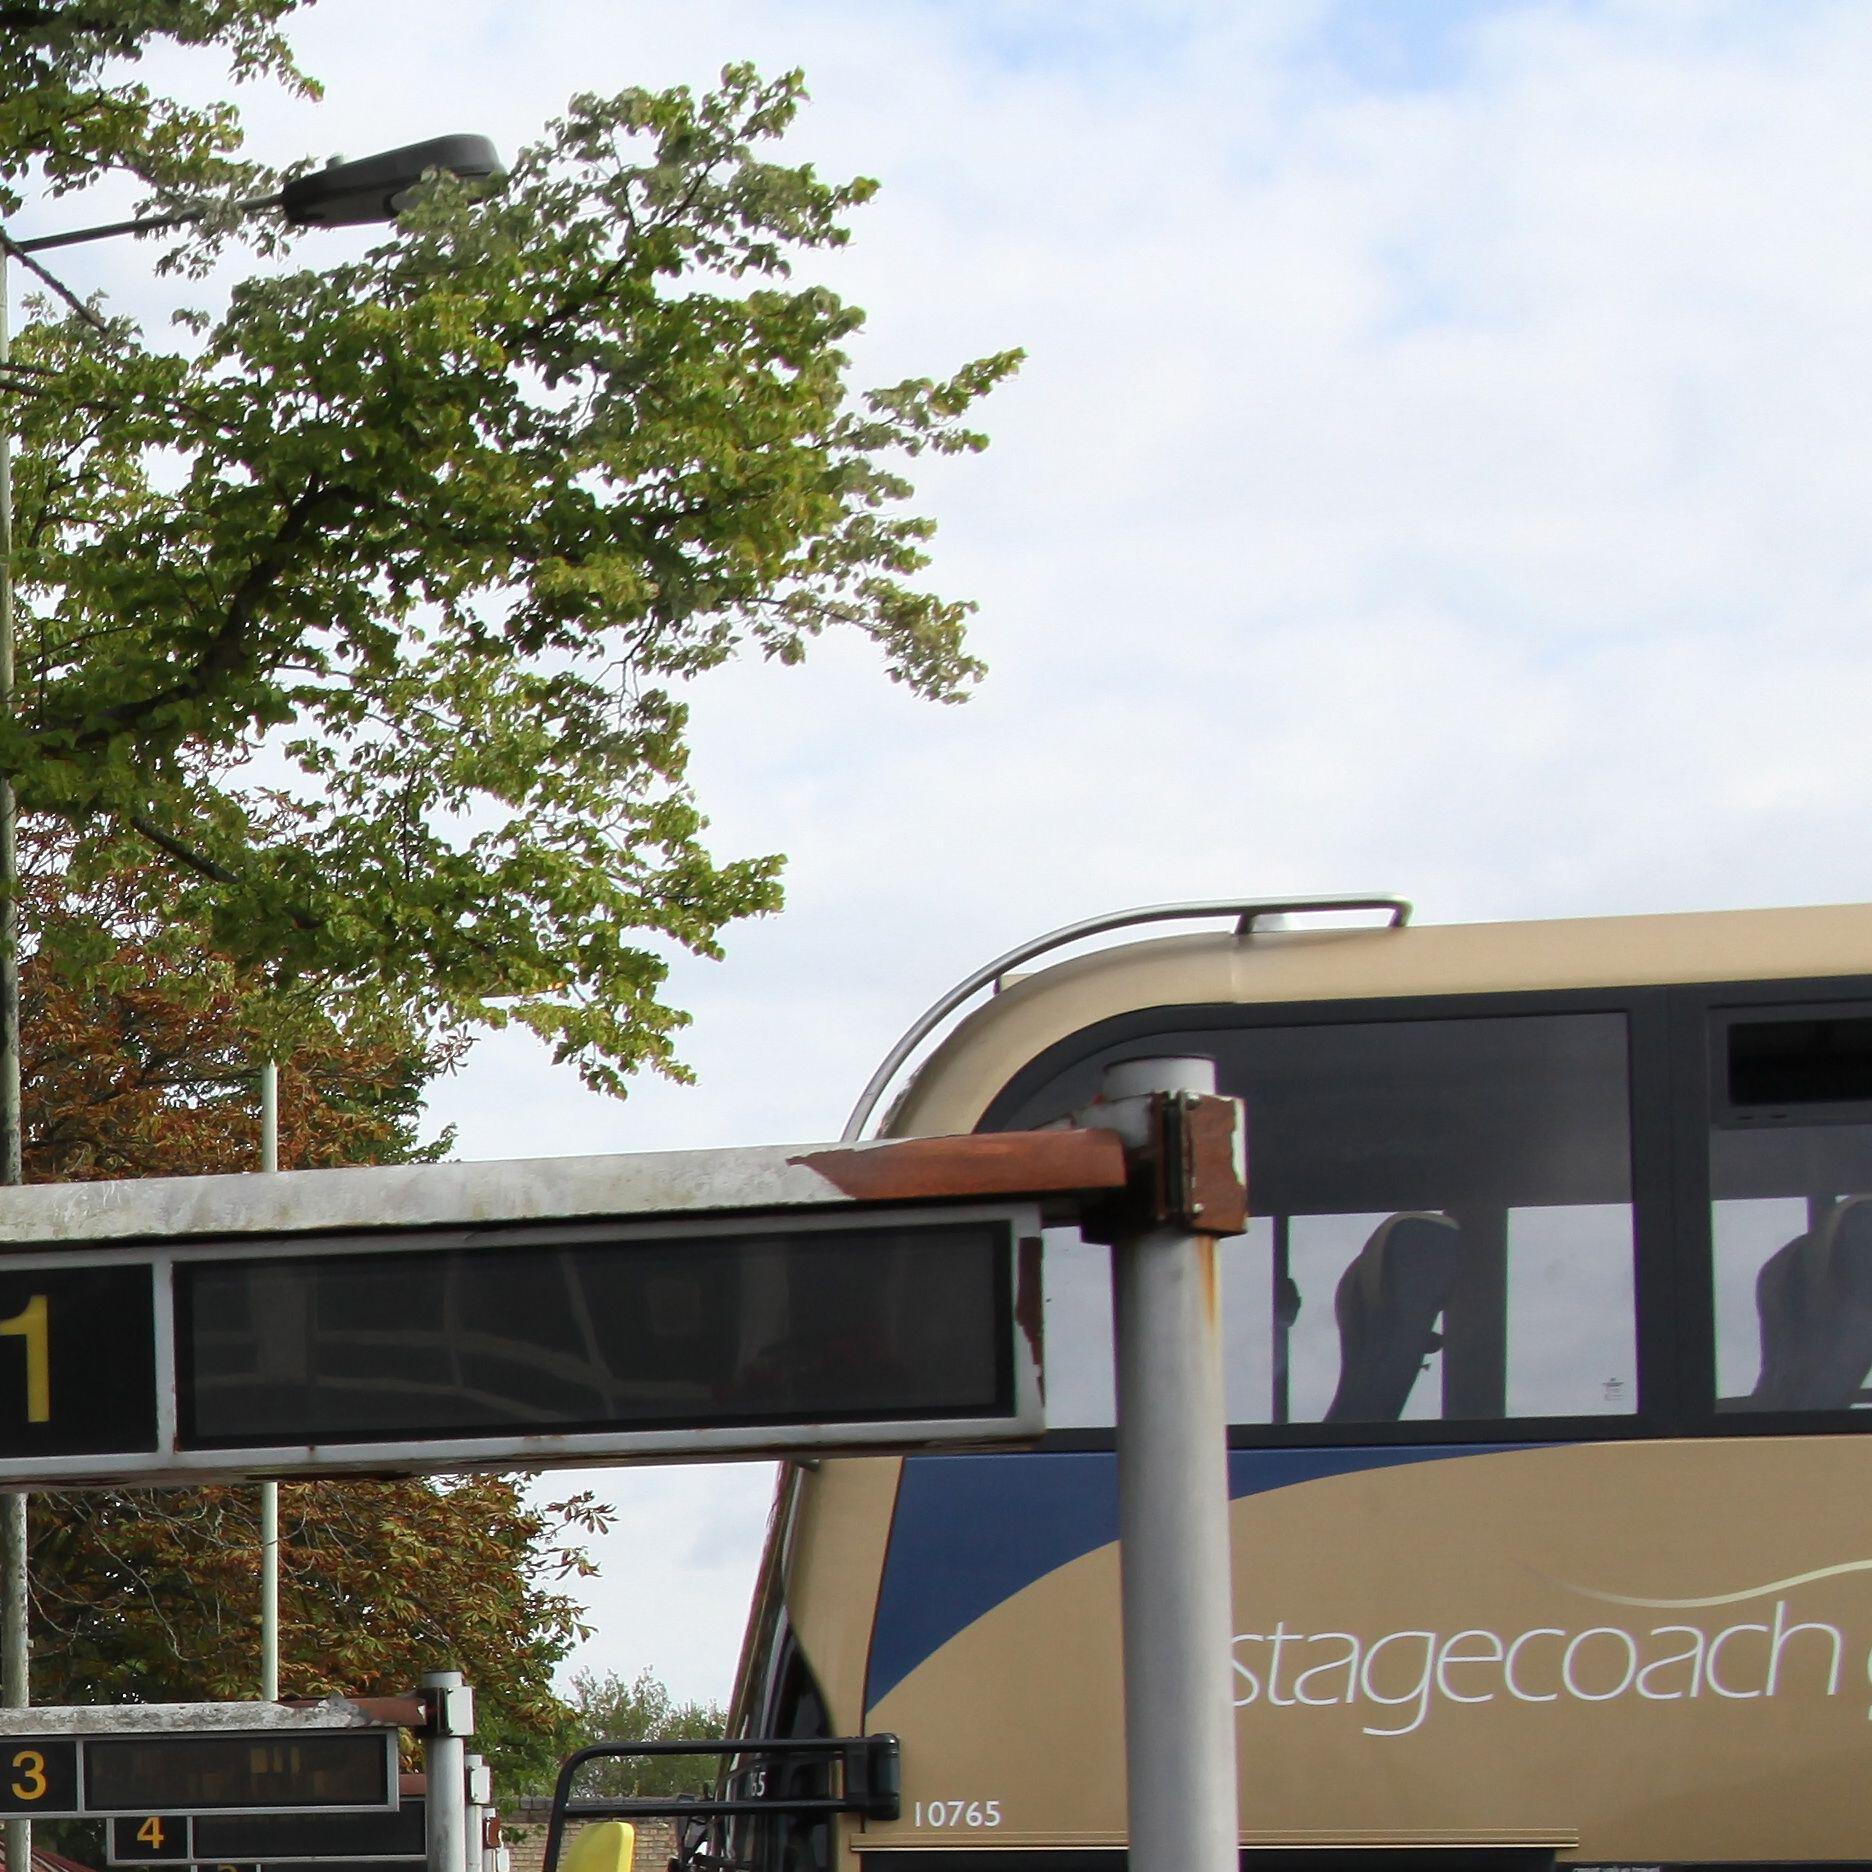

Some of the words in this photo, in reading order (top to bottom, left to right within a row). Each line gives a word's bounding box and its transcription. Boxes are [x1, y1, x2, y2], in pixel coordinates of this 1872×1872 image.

[1231, 1600, 1843, 1736] stagecoach
[11, 1750, 47, 1800] 3
[137, 1816, 164, 1849] 4
[914, 1801, 1000, 1827] 10765
